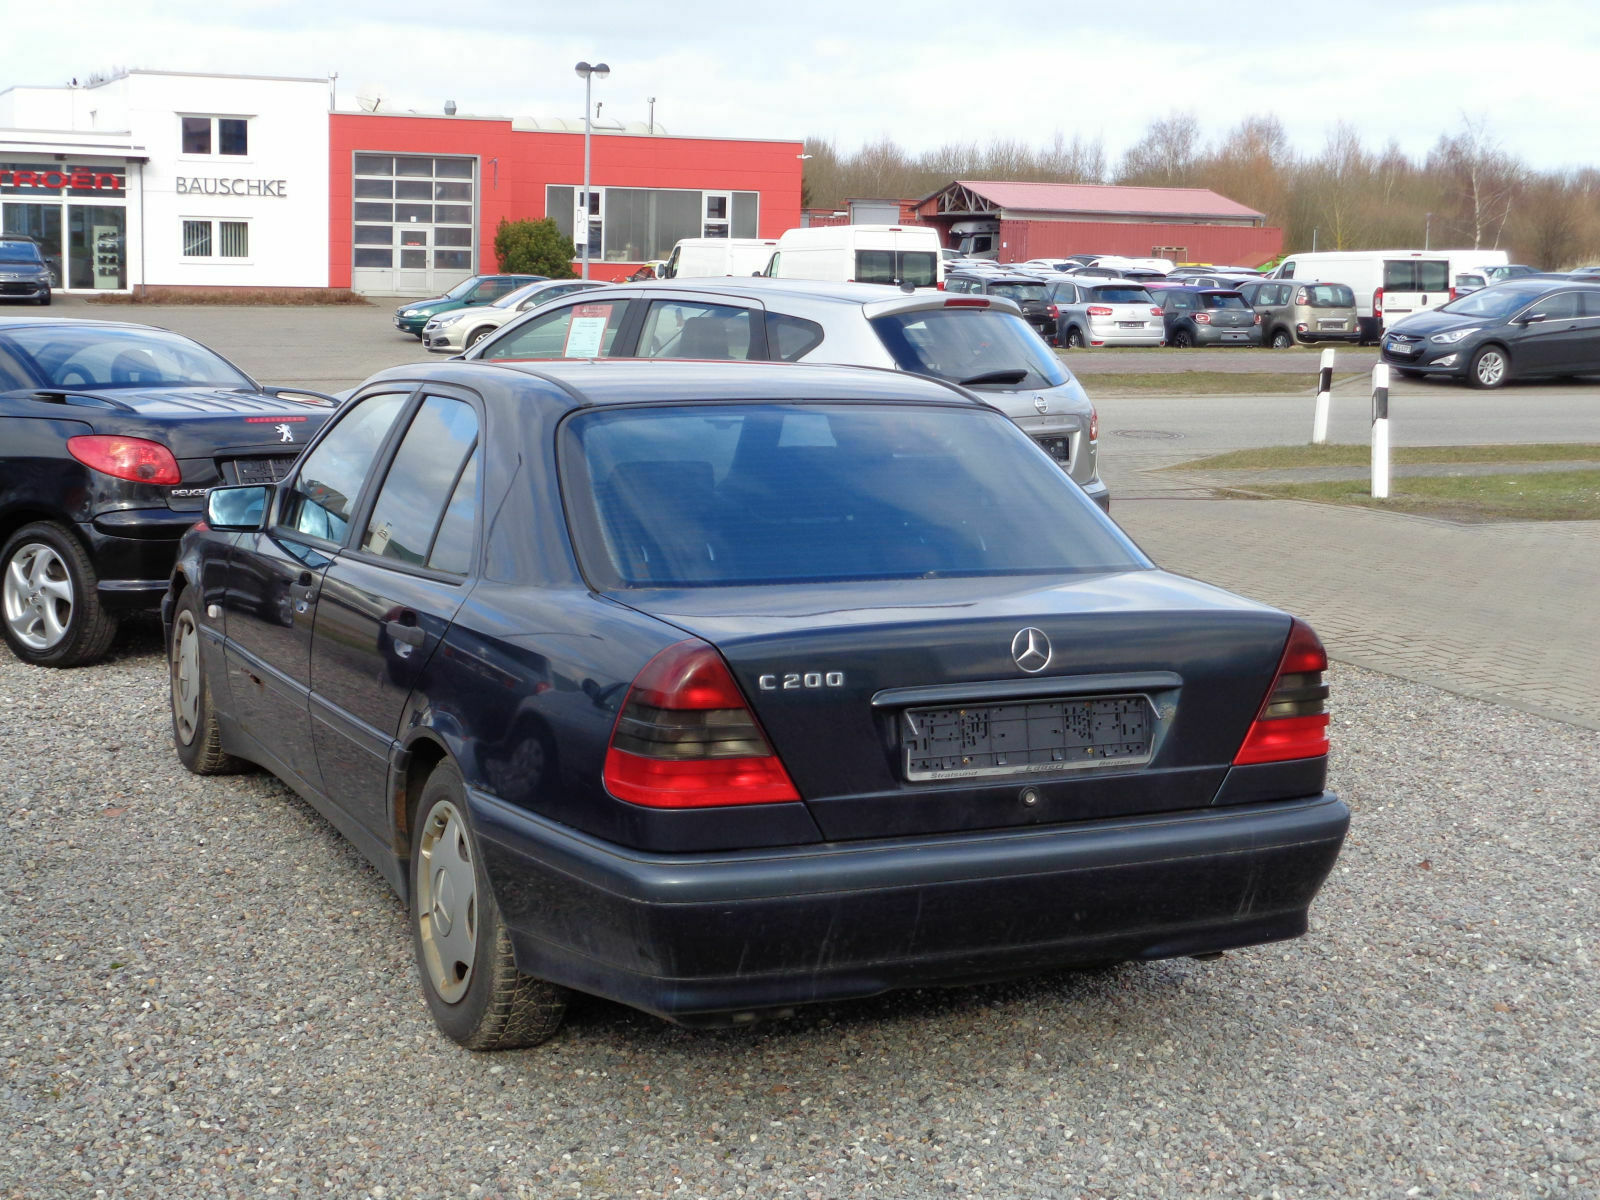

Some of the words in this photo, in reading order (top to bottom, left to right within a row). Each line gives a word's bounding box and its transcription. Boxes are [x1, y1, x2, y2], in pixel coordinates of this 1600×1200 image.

[176, 176, 287, 197] BAUSCHKE
[171, 488, 210, 497] PEUGE
[930, 770, 978, 780] Stralsund
